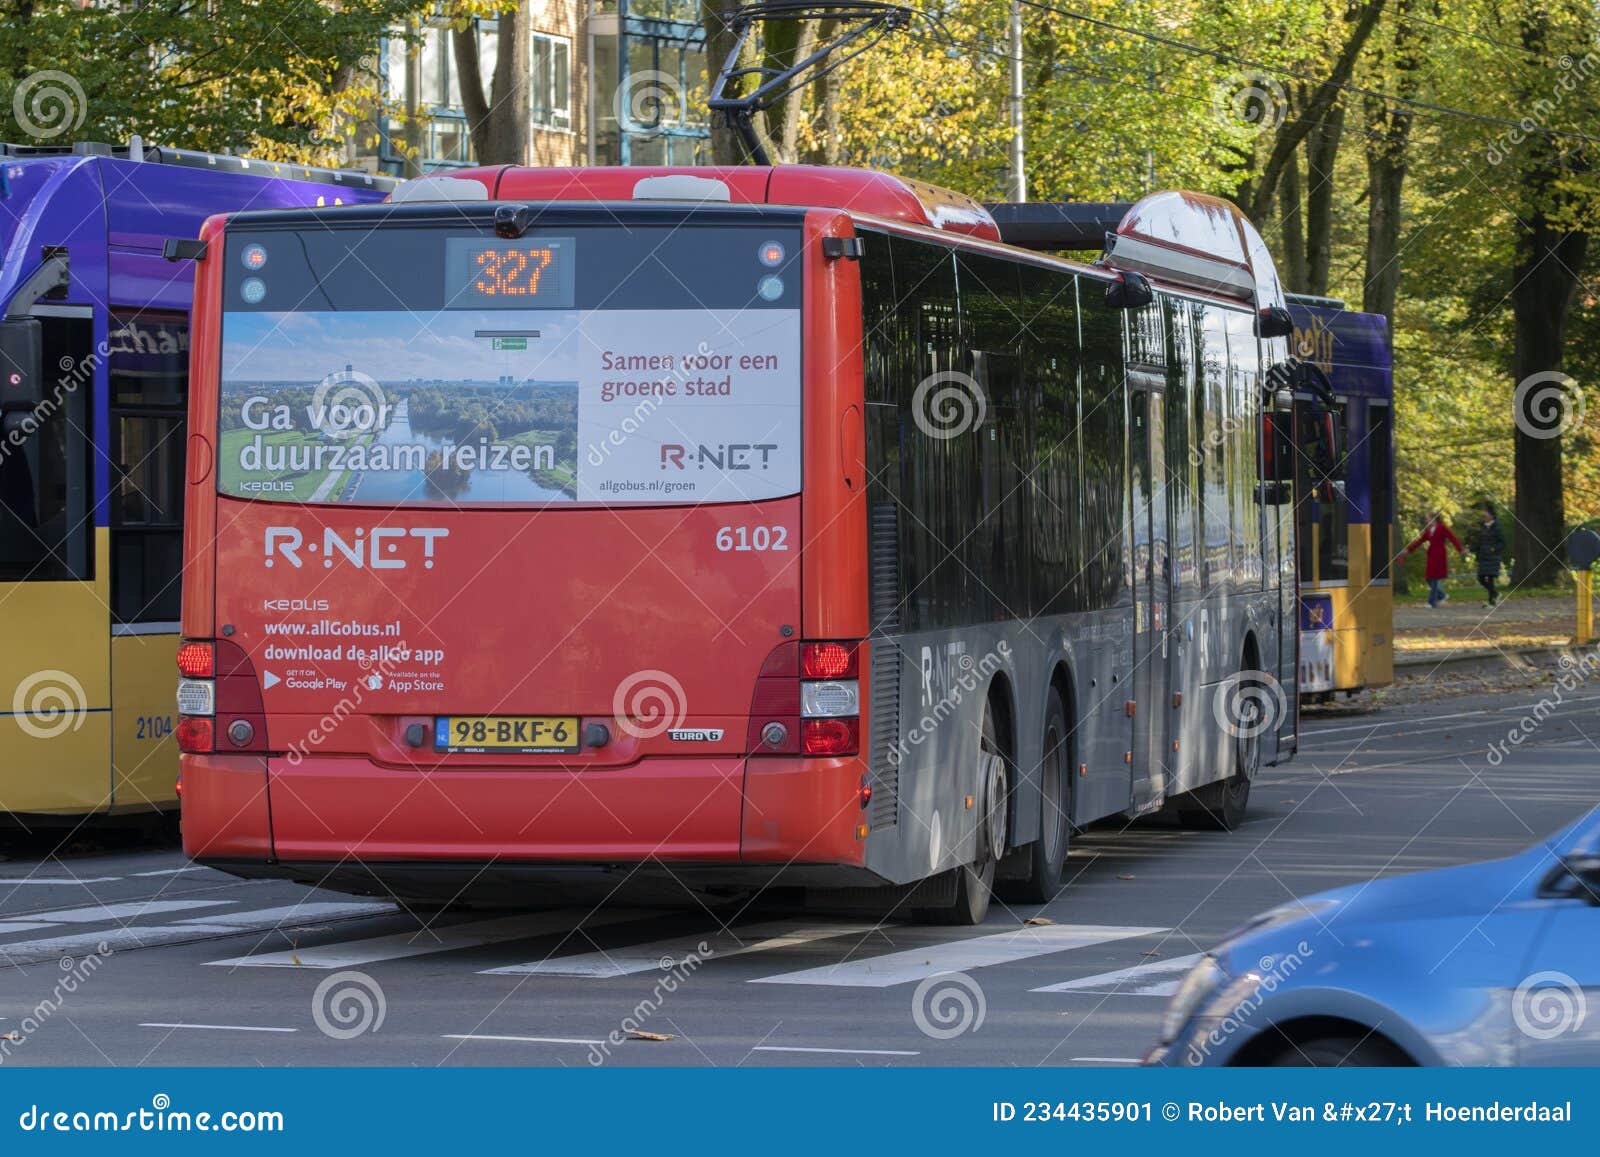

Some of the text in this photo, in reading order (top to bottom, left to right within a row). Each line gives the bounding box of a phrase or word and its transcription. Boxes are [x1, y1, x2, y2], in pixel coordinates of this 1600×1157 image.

[477, 249, 551, 295] 327
[602, 351, 778, 370] Samen voor een
[601, 375, 731, 402] groene stad
[241, 396, 392, 430] Ga voor
[240, 435, 555, 471] duurzaam reizen
[599, 480, 696, 493] allgobus.nl/groen
[715, 526, 789, 551] 6102
[264, 620, 401, 636] www.allGobus.nl
[264, 644, 444, 665] download de allGo app
[286, 677, 348, 691] Google Play
[388, 680, 445, 693] App Store
[136, 715, 173, 739] 2104
[455, 720, 569, 743] 98-BKF-6
[672, 731, 720, 741] EURO 6
